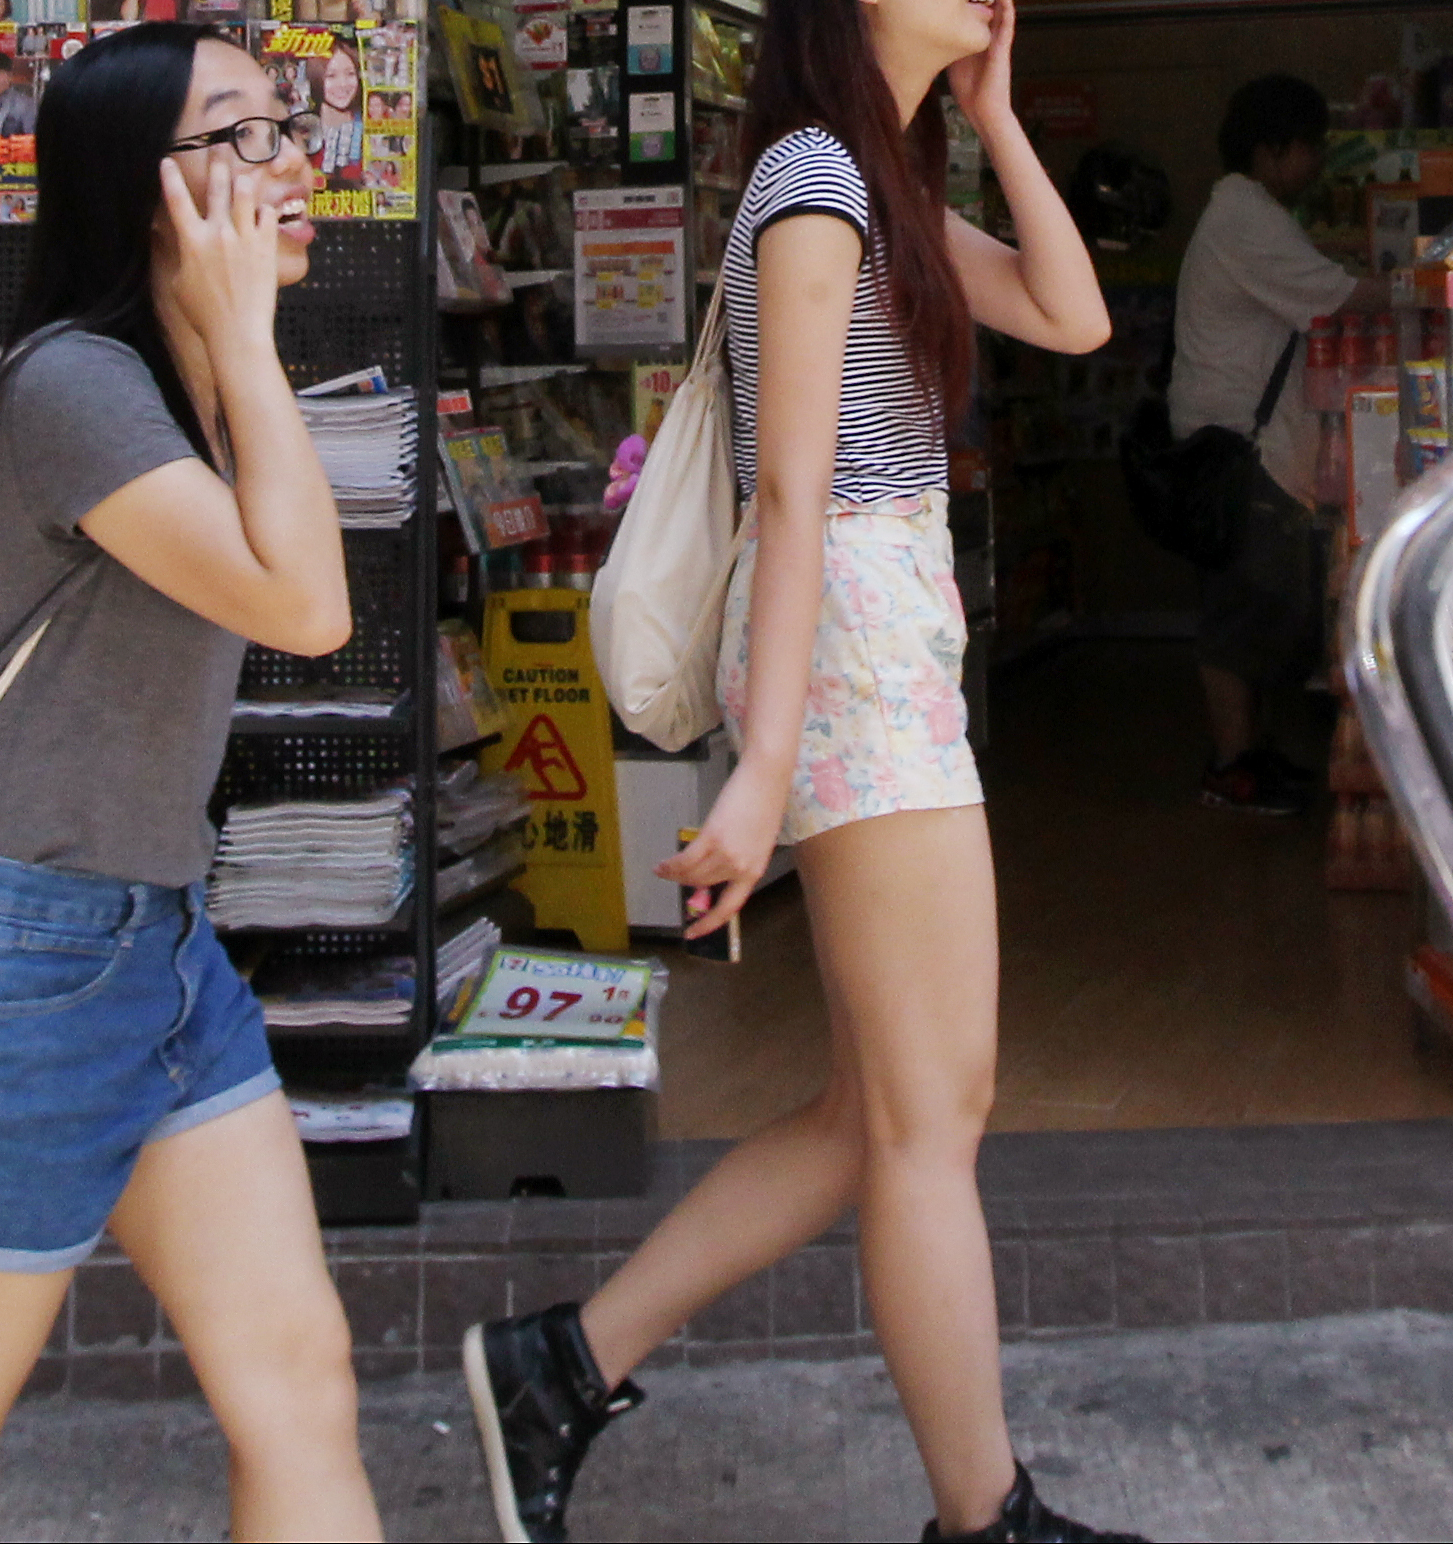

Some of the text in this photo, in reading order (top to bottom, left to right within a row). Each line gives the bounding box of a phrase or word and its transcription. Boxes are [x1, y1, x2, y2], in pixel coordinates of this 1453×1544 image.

[502, 668, 580, 684] CAUTION
[533, 688, 590, 704] FLOOR
[499, 985, 584, 1022] 97
